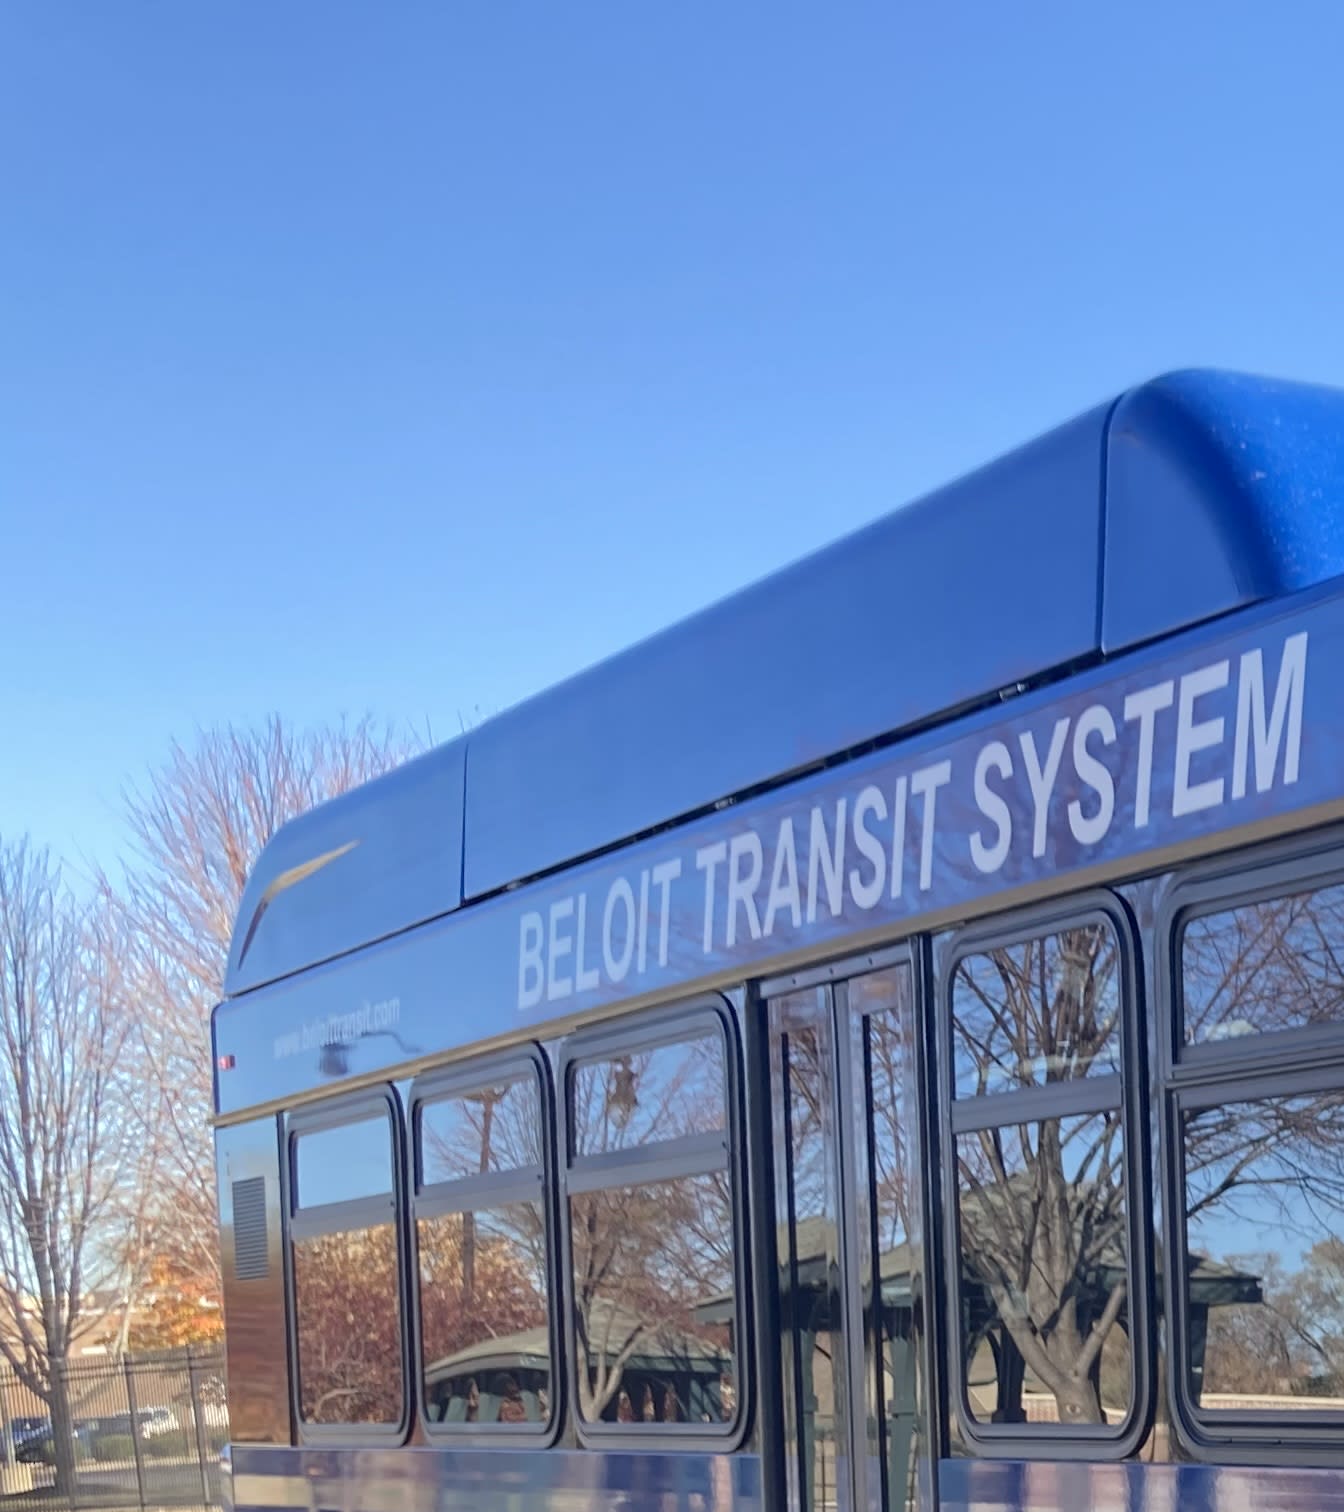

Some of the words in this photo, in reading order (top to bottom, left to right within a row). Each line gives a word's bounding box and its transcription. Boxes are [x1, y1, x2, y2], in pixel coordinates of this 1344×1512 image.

[517, 858, 682, 1009] BELOIT
[696, 759, 951, 955] TRANSIT
[968, 631, 1309, 874] SYSTEM
